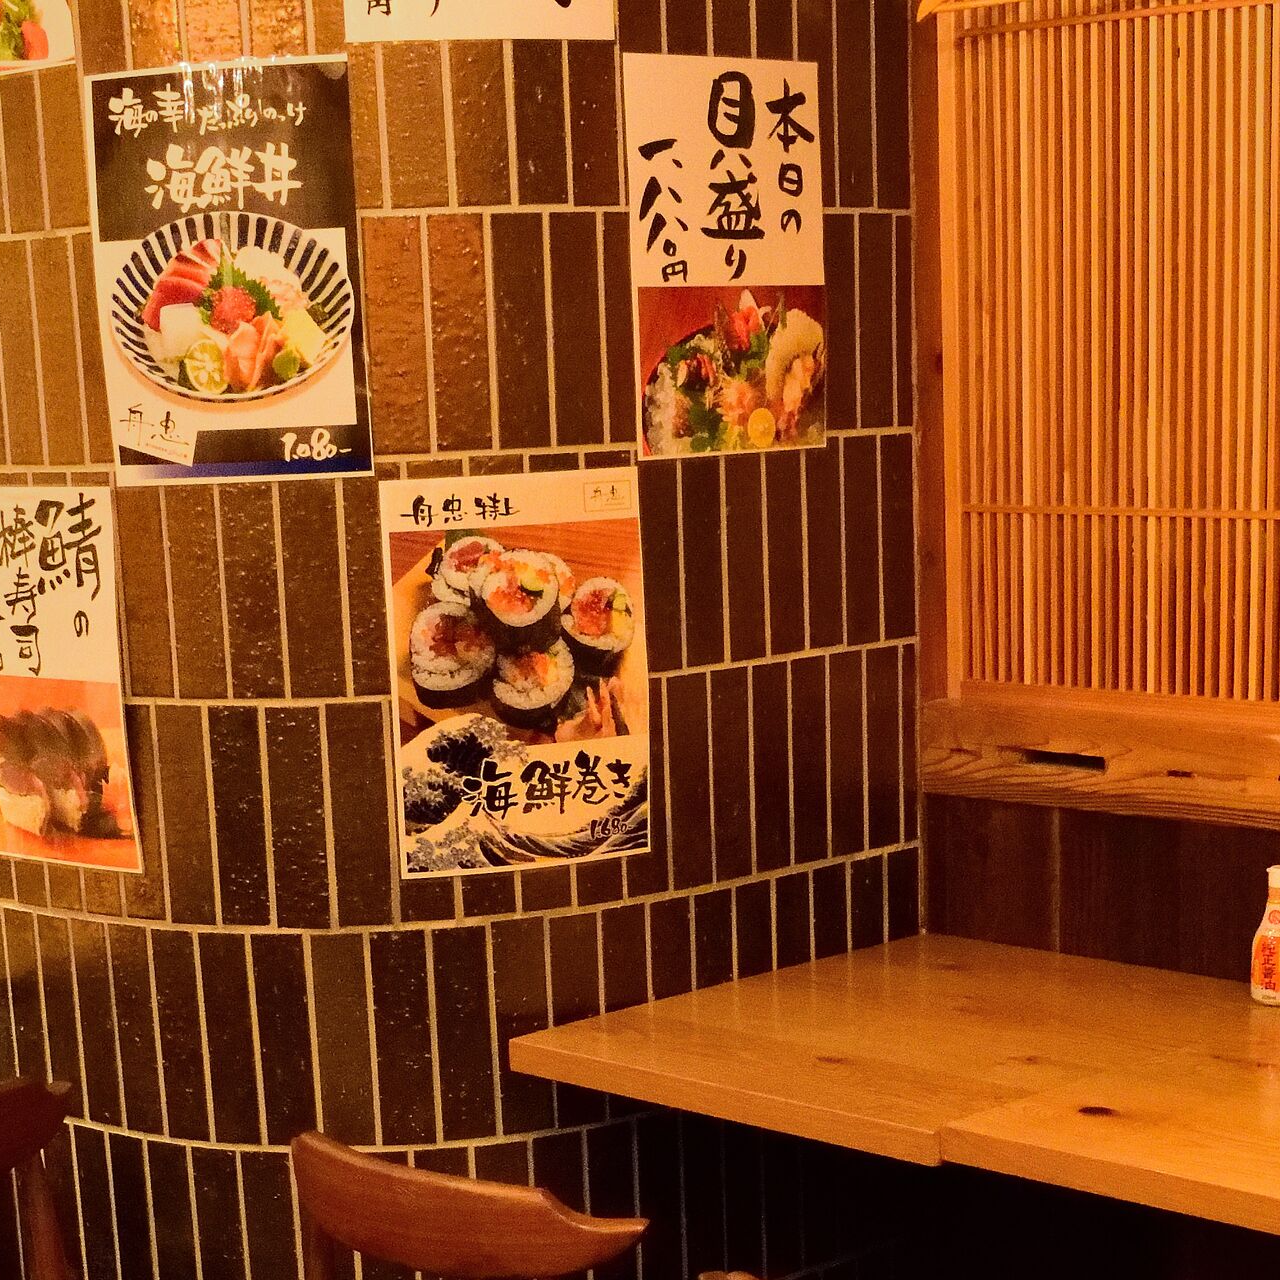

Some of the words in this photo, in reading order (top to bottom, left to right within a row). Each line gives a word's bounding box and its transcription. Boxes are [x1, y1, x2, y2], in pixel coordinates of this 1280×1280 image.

[144, 141, 304, 214] 海鮮丼
[700, 70, 766, 282] 貝盛り
[765, 77, 816, 235] 本日の
[33, 491, 103, 638] 鯖の
[461, 749, 633, 821] 海鮮巻き
